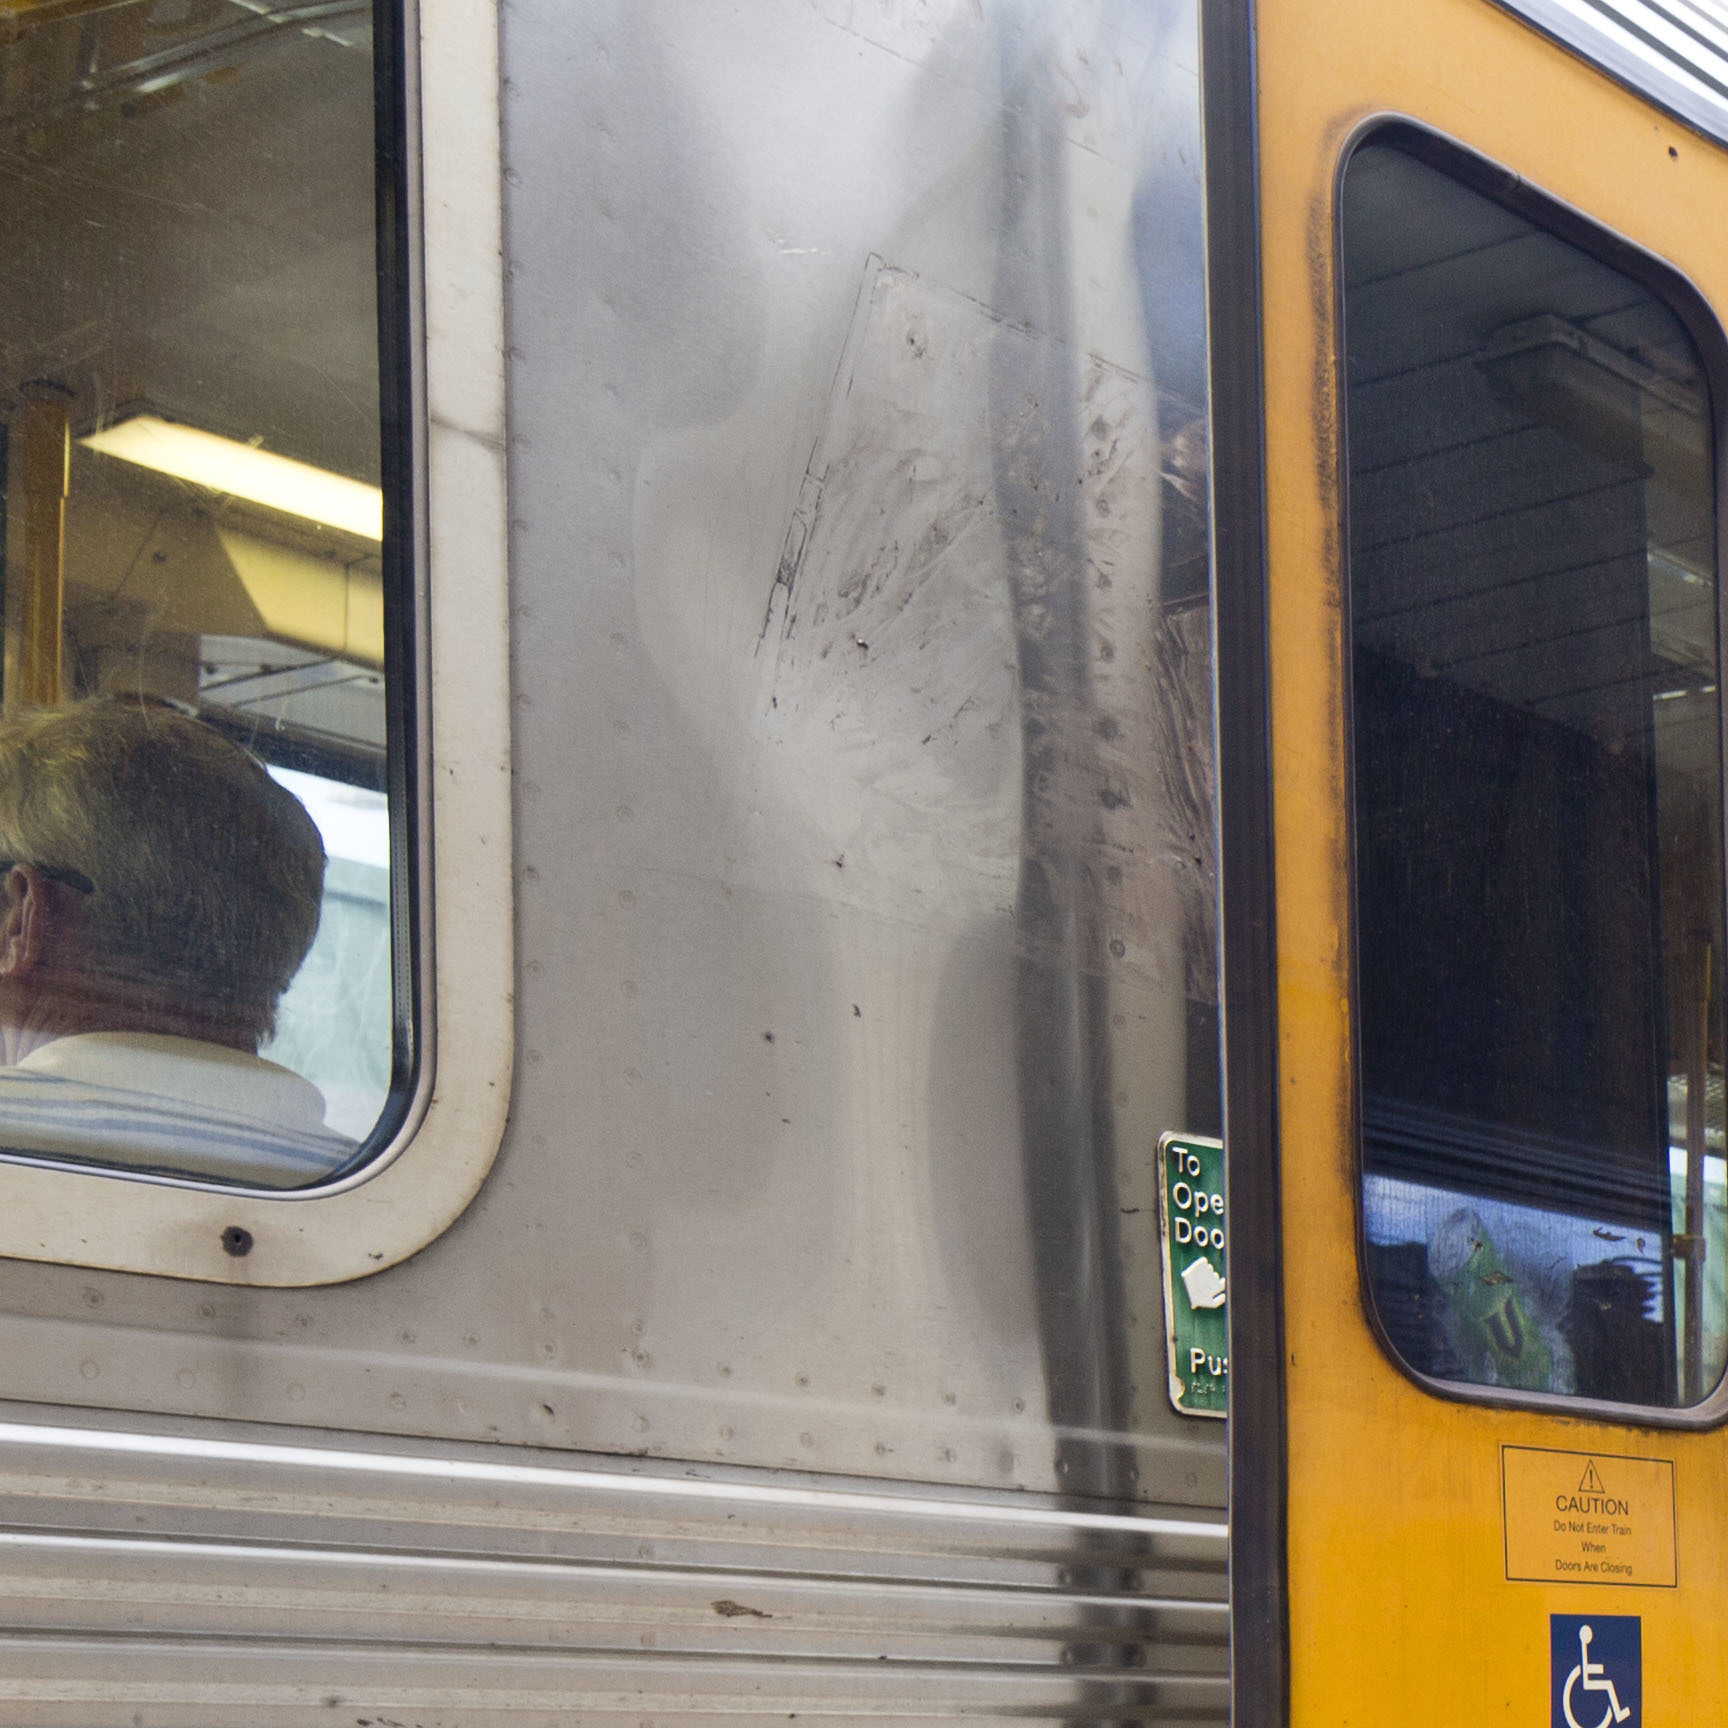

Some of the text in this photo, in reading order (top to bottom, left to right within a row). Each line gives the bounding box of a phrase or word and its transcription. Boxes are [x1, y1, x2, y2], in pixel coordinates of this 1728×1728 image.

[1172, 1147, 1200, 1176] To
[1556, 1495, 1629, 1516] CAUTION
[1553, 1519, 1632, 1536] Do Not Enter Train
[1581, 1541, 1606, 1553] When
[1555, 1559, 1632, 1577] Doors Are Closing
